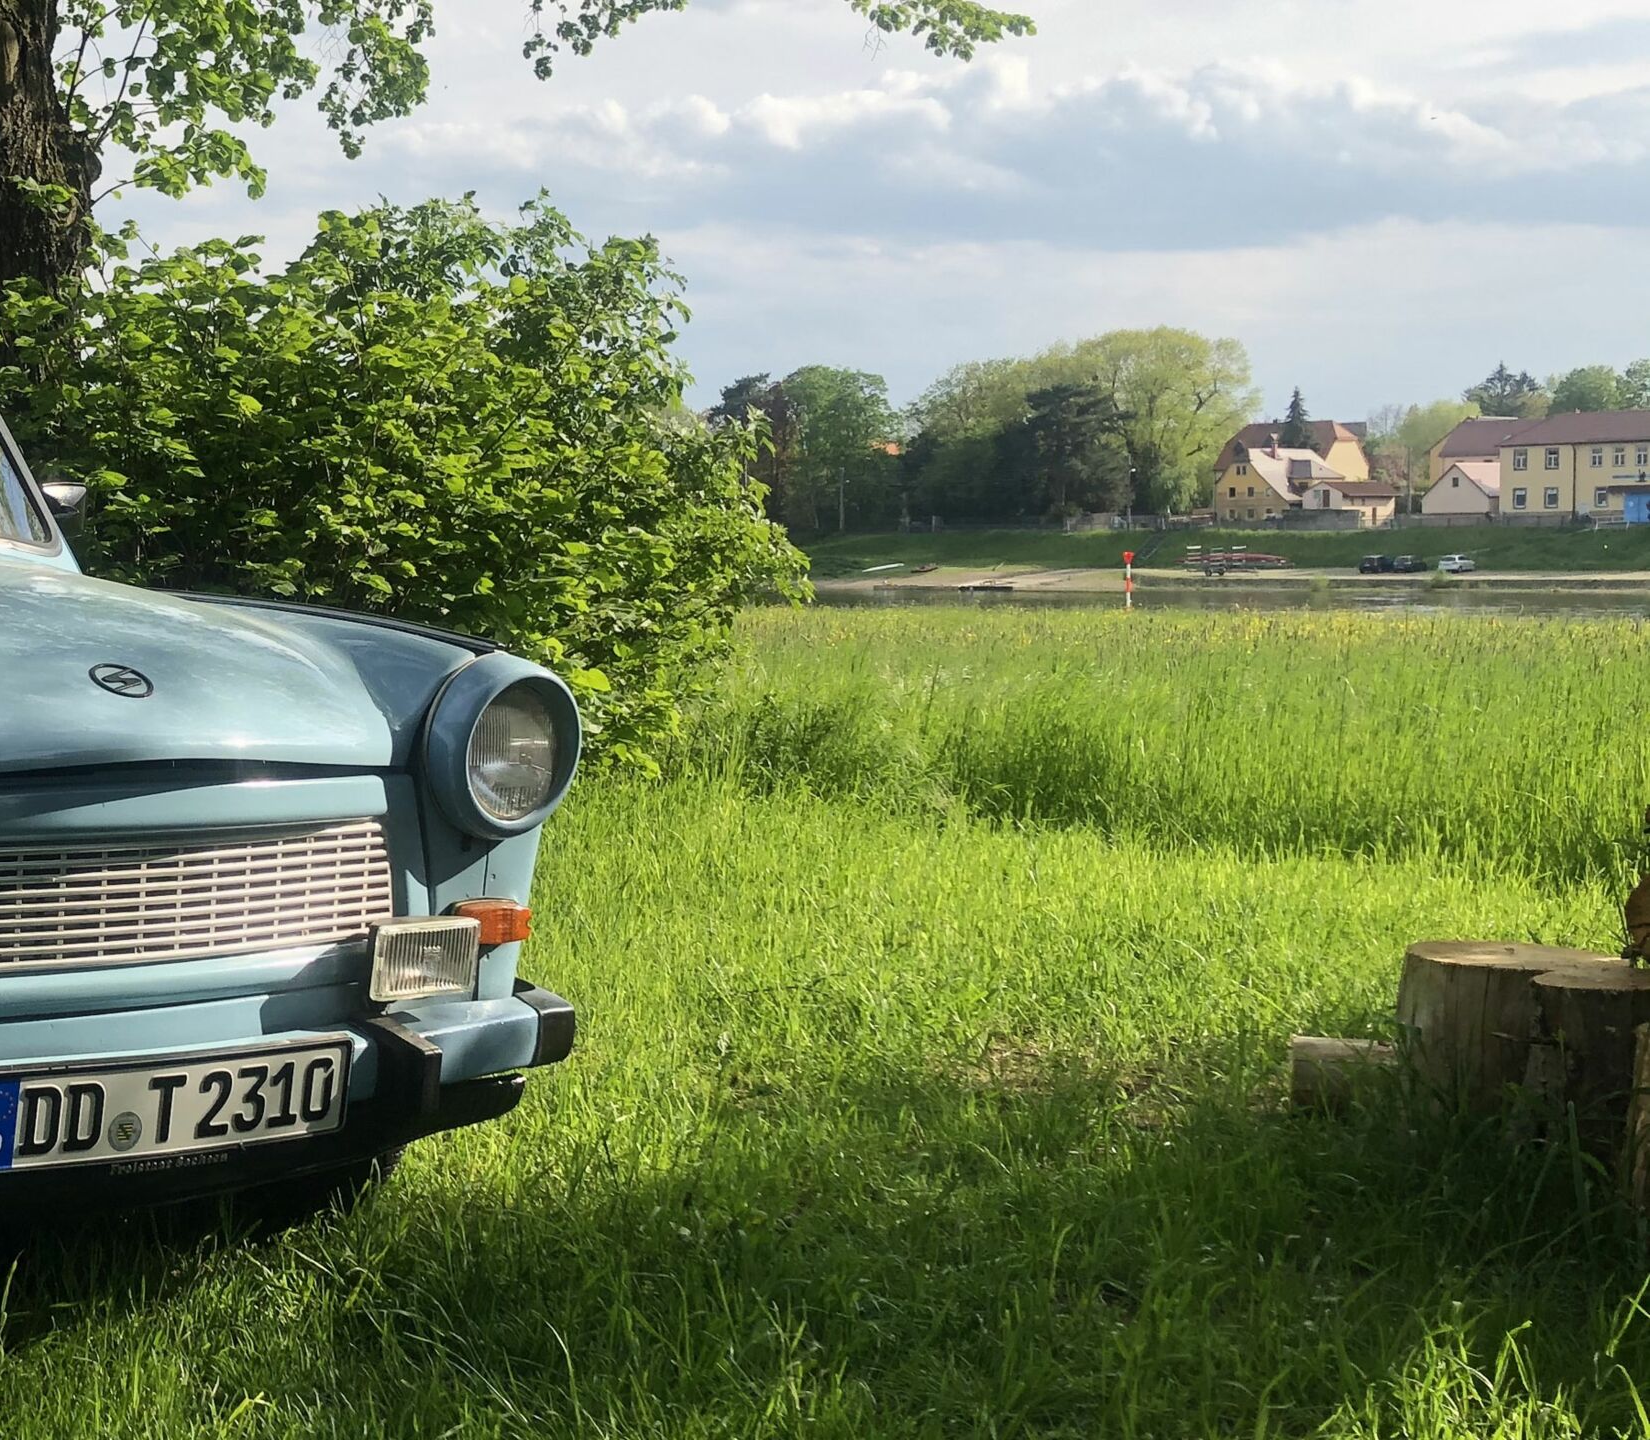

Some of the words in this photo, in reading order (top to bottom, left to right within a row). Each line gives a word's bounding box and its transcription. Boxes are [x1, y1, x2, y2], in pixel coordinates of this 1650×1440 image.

[18, 1085, 106, 1155] DD
[149, 1074, 187, 1143] T
[195, 1057, 335, 1139] 2310
